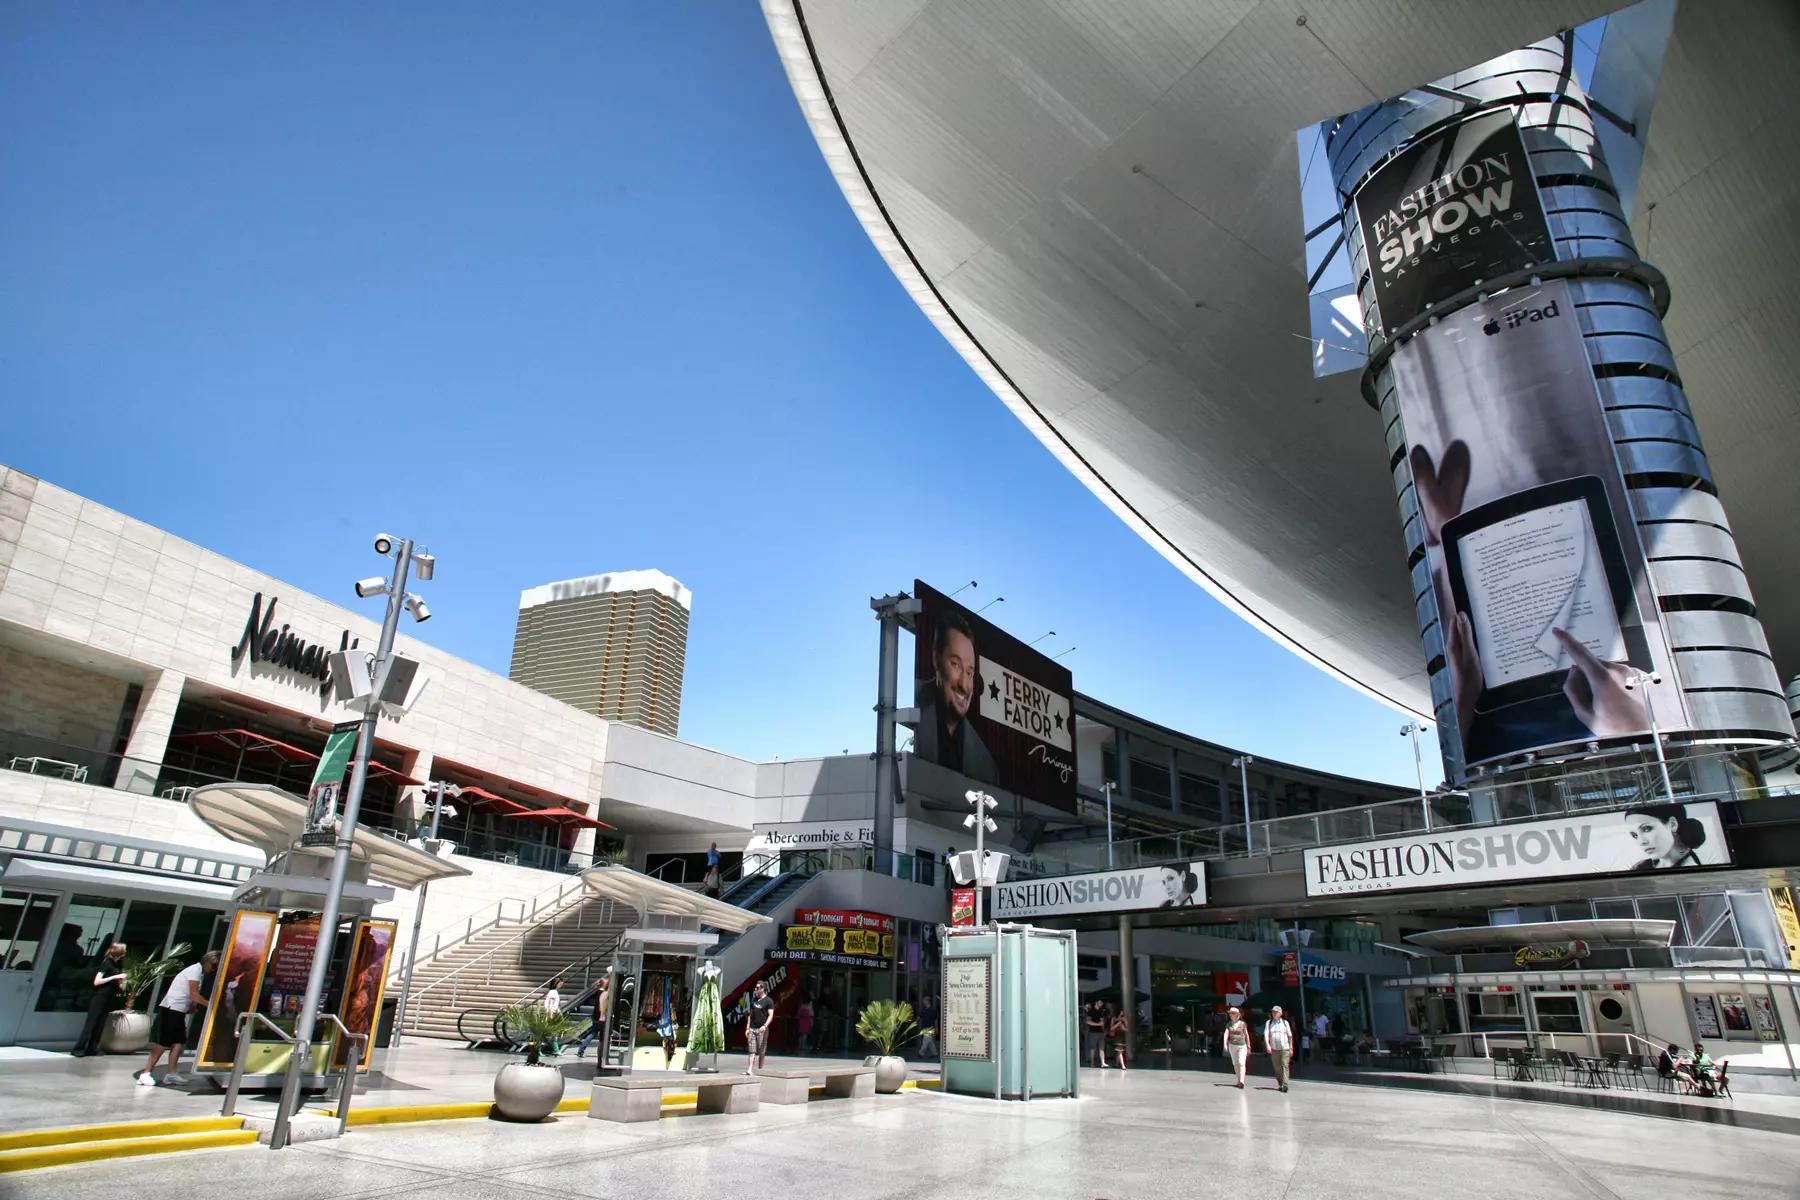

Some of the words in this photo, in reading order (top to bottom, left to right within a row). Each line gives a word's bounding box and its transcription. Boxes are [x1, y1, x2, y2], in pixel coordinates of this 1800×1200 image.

[1372, 152, 1512, 246] FASHION
[1379, 180, 1513, 273] SHOW
[1385, 257, 1420, 288] LAS
[1431, 212, 1524, 253] VEGAS
[1506, 299, 1560, 329] iPad
[231, 592, 332, 682] Neiman
[1002, 671, 1050, 713] TERRY
[1004, 697, 1052, 739] FATOR
[764, 829, 840, 844] Abercrombie
[843, 831, 854, 841] &
[858, 828, 875, 841] Fit
[1320, 885, 1343, 894] LAS
[1349, 881, 1392, 892] VEGAS
[1297, 963, 1346, 980] ECHERS
